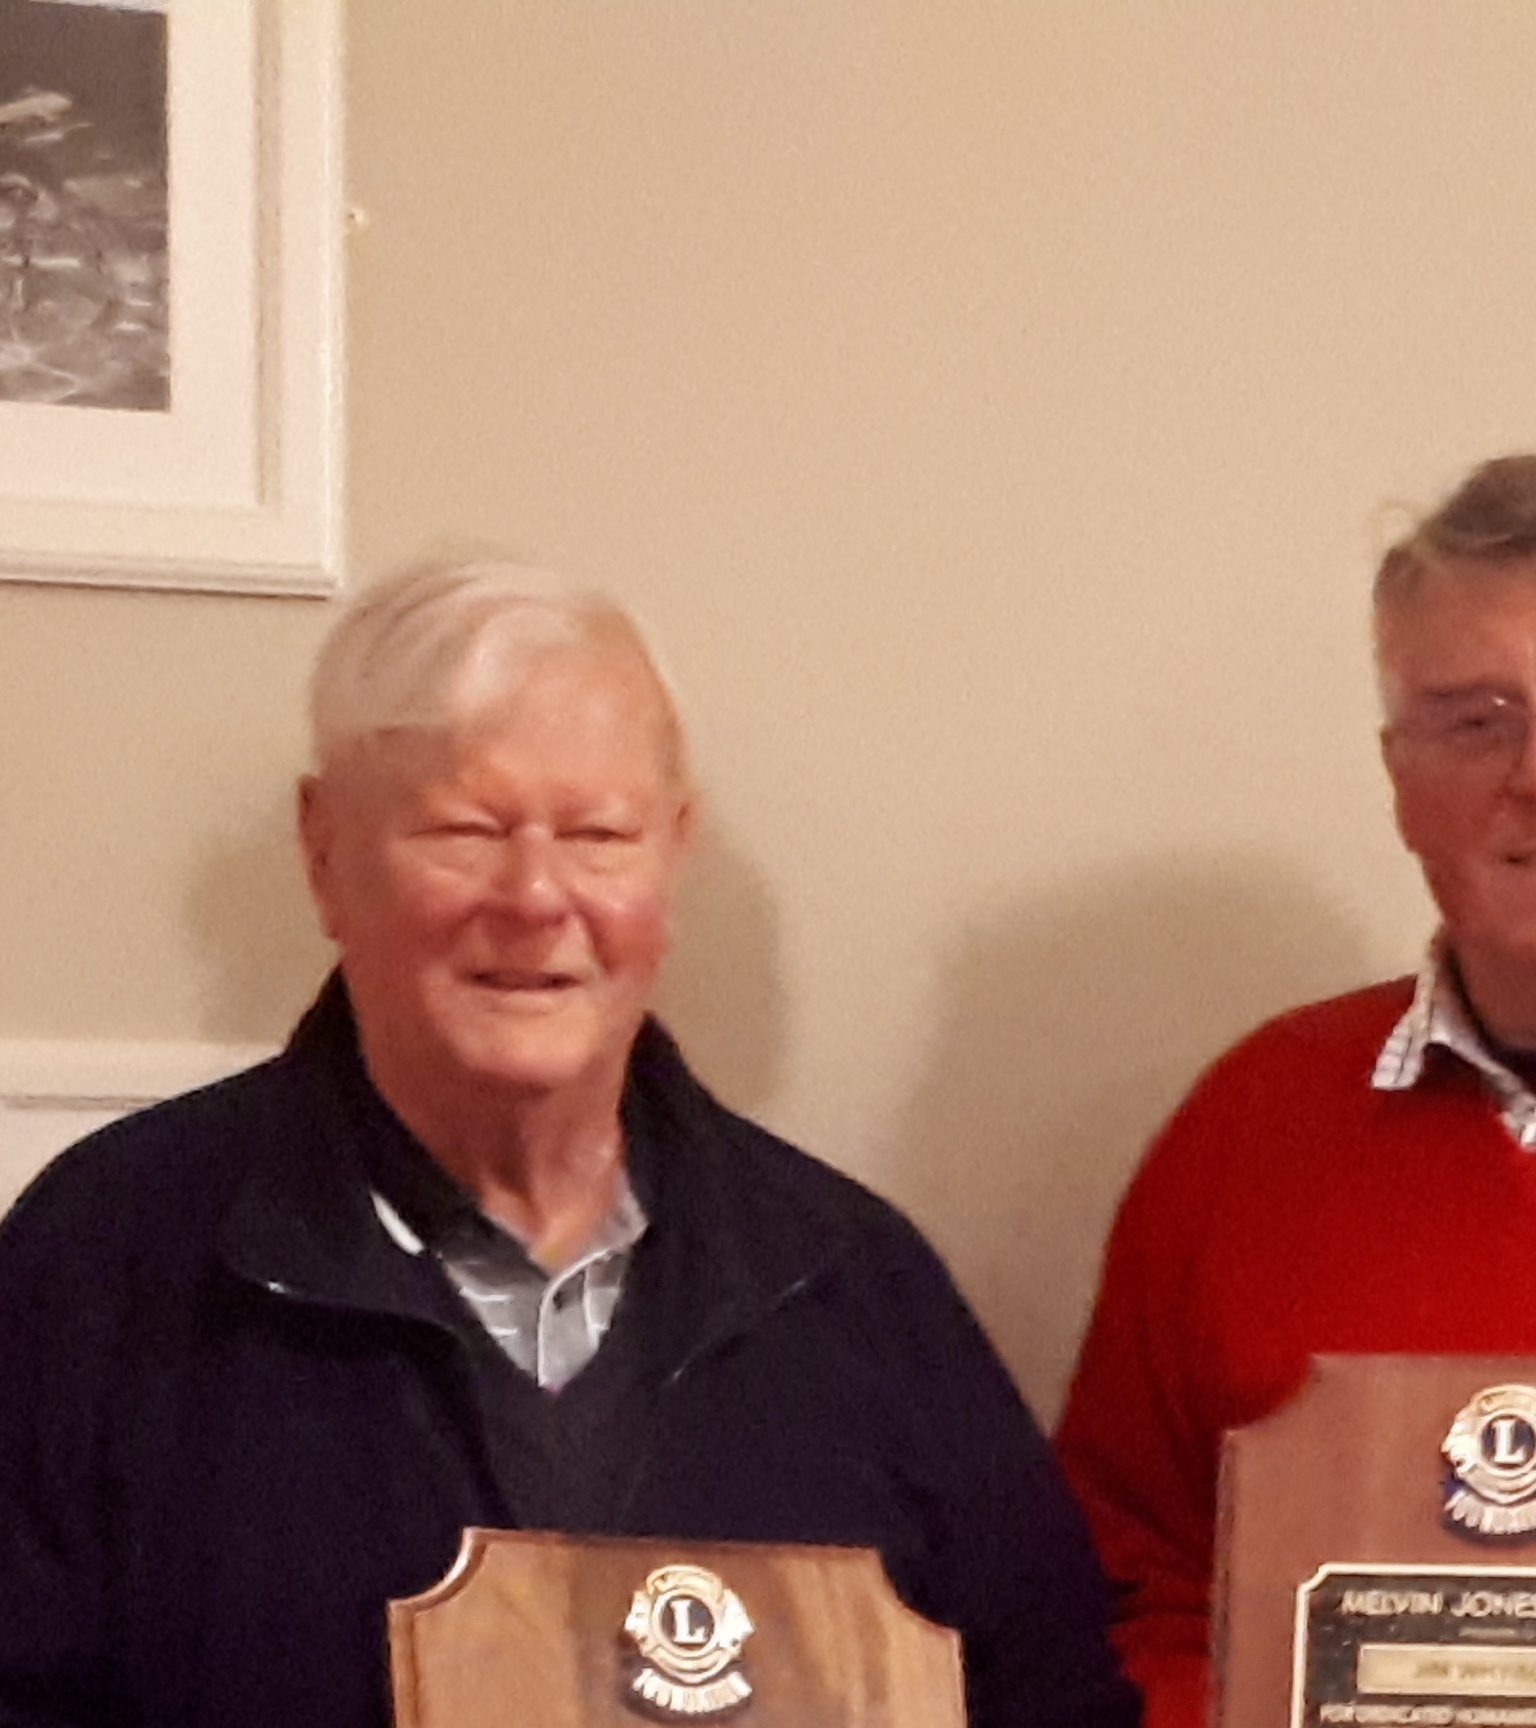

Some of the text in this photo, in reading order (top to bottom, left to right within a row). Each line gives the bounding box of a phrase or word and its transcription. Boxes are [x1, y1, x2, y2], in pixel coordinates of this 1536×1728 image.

[1492, 1419, 1528, 1463] L
[670, 1600, 708, 1643] L
[1340, 1590, 1444, 1616] MELVIN
